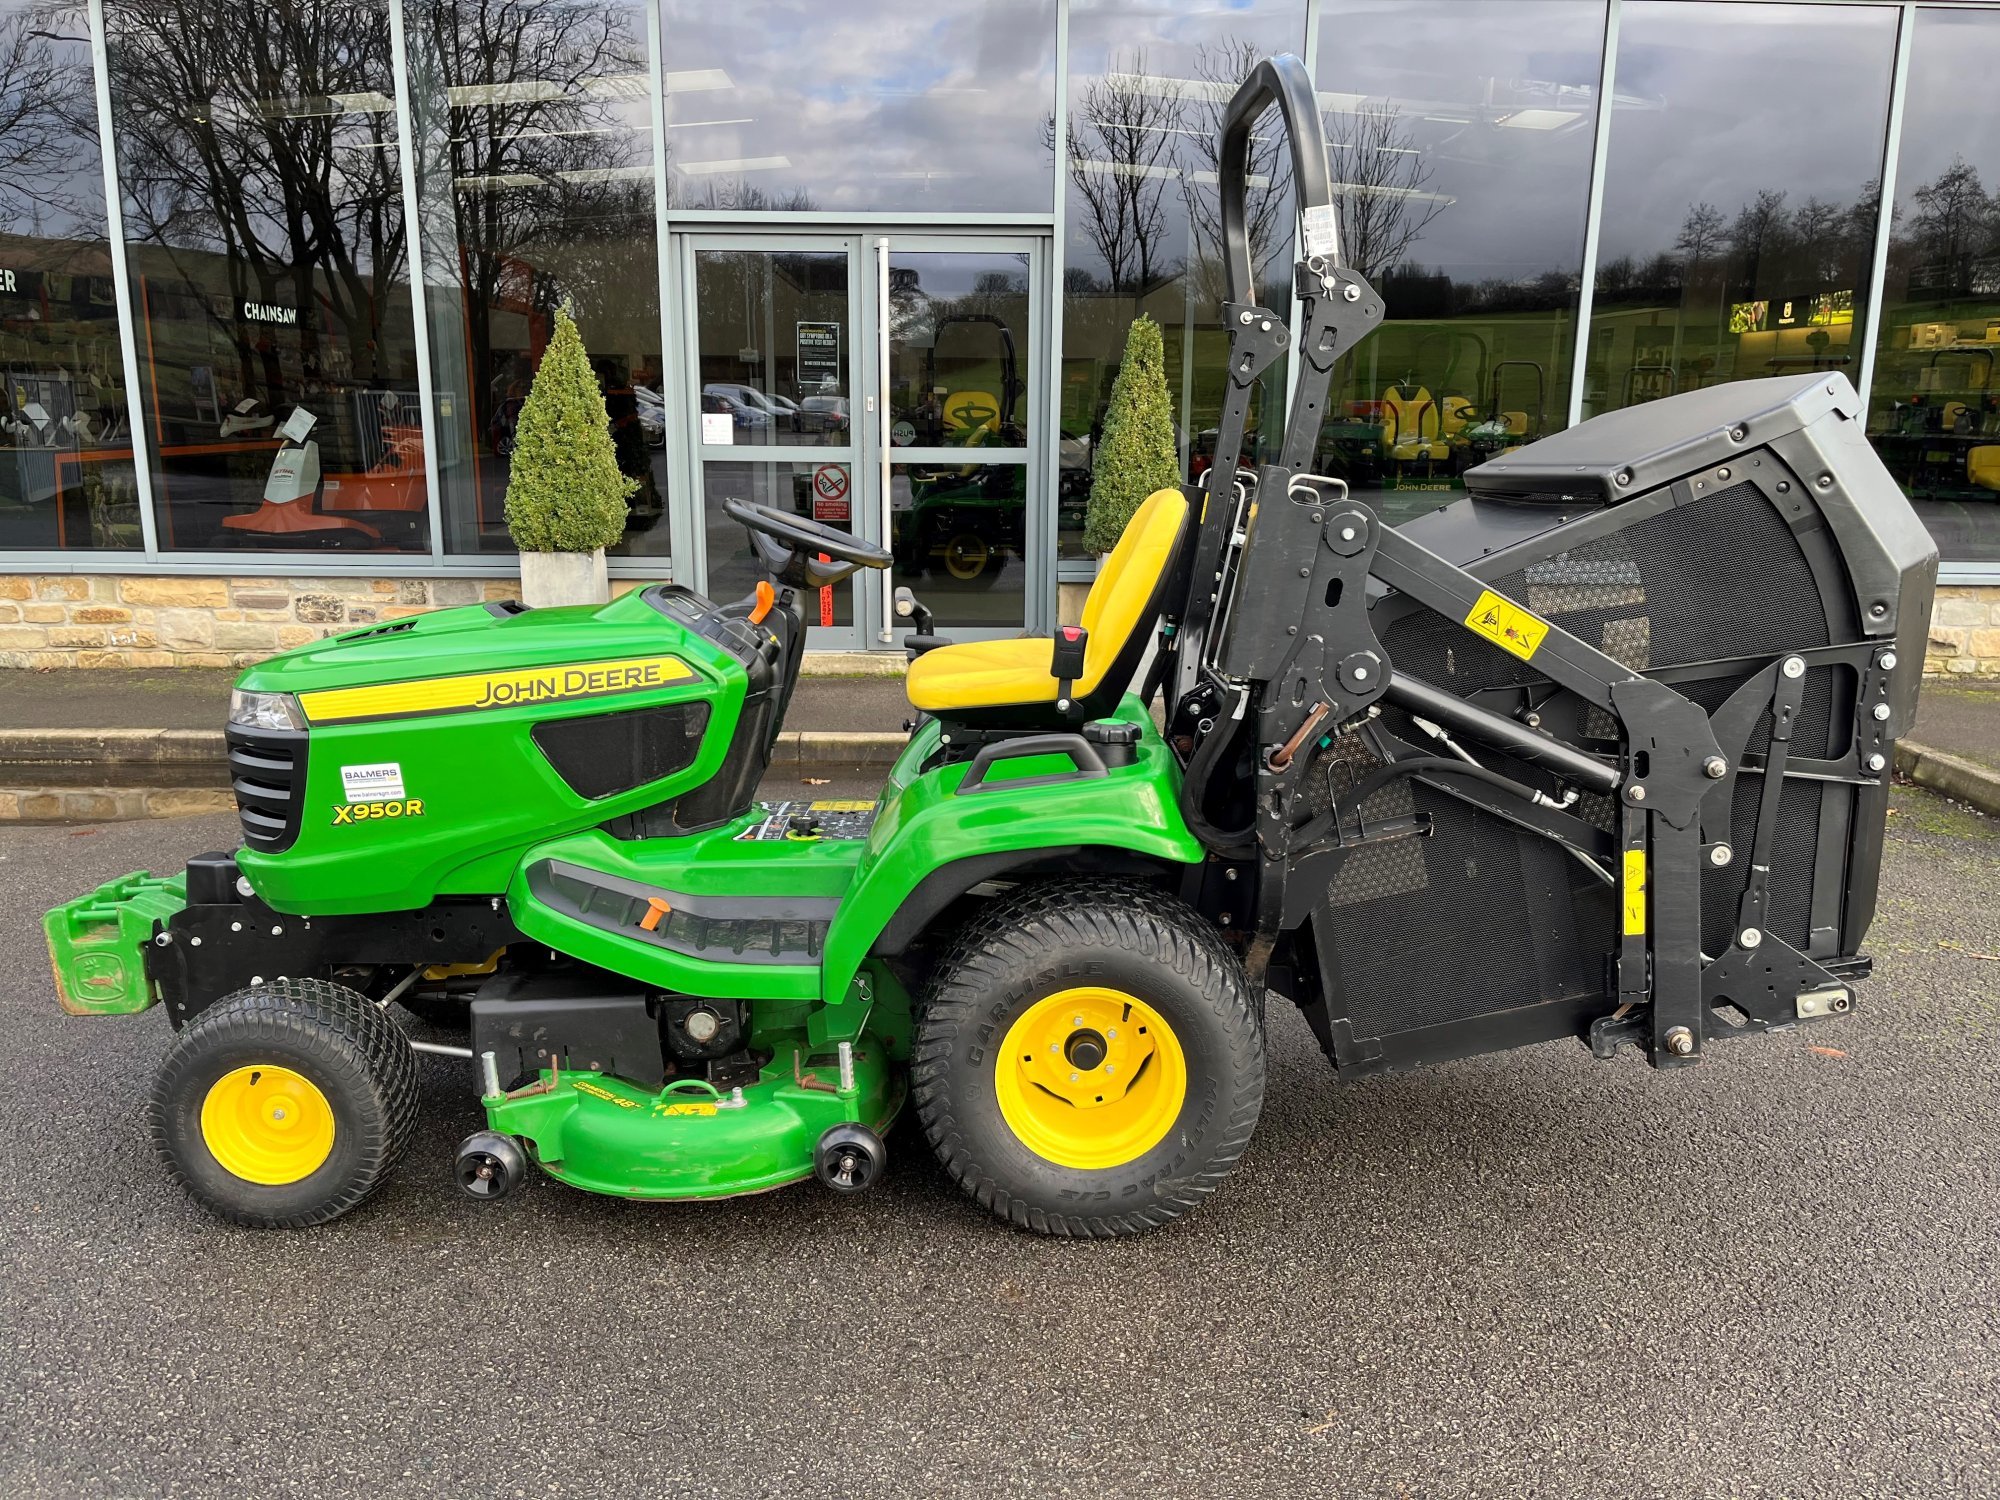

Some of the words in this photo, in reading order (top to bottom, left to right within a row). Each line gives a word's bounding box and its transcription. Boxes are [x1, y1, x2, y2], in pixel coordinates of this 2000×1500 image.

[244, 302, 297, 324] CHAINSAW
[1393, 483, 1419, 491] JOHN
[1420, 483, 1452, 492] DEERE
[475, 677, 557, 706] JOHN
[563, 664, 663, 695] DEERE
[344, 769, 398, 780] BALMERS
[966, 960, 1105, 1069] CARLISLE
